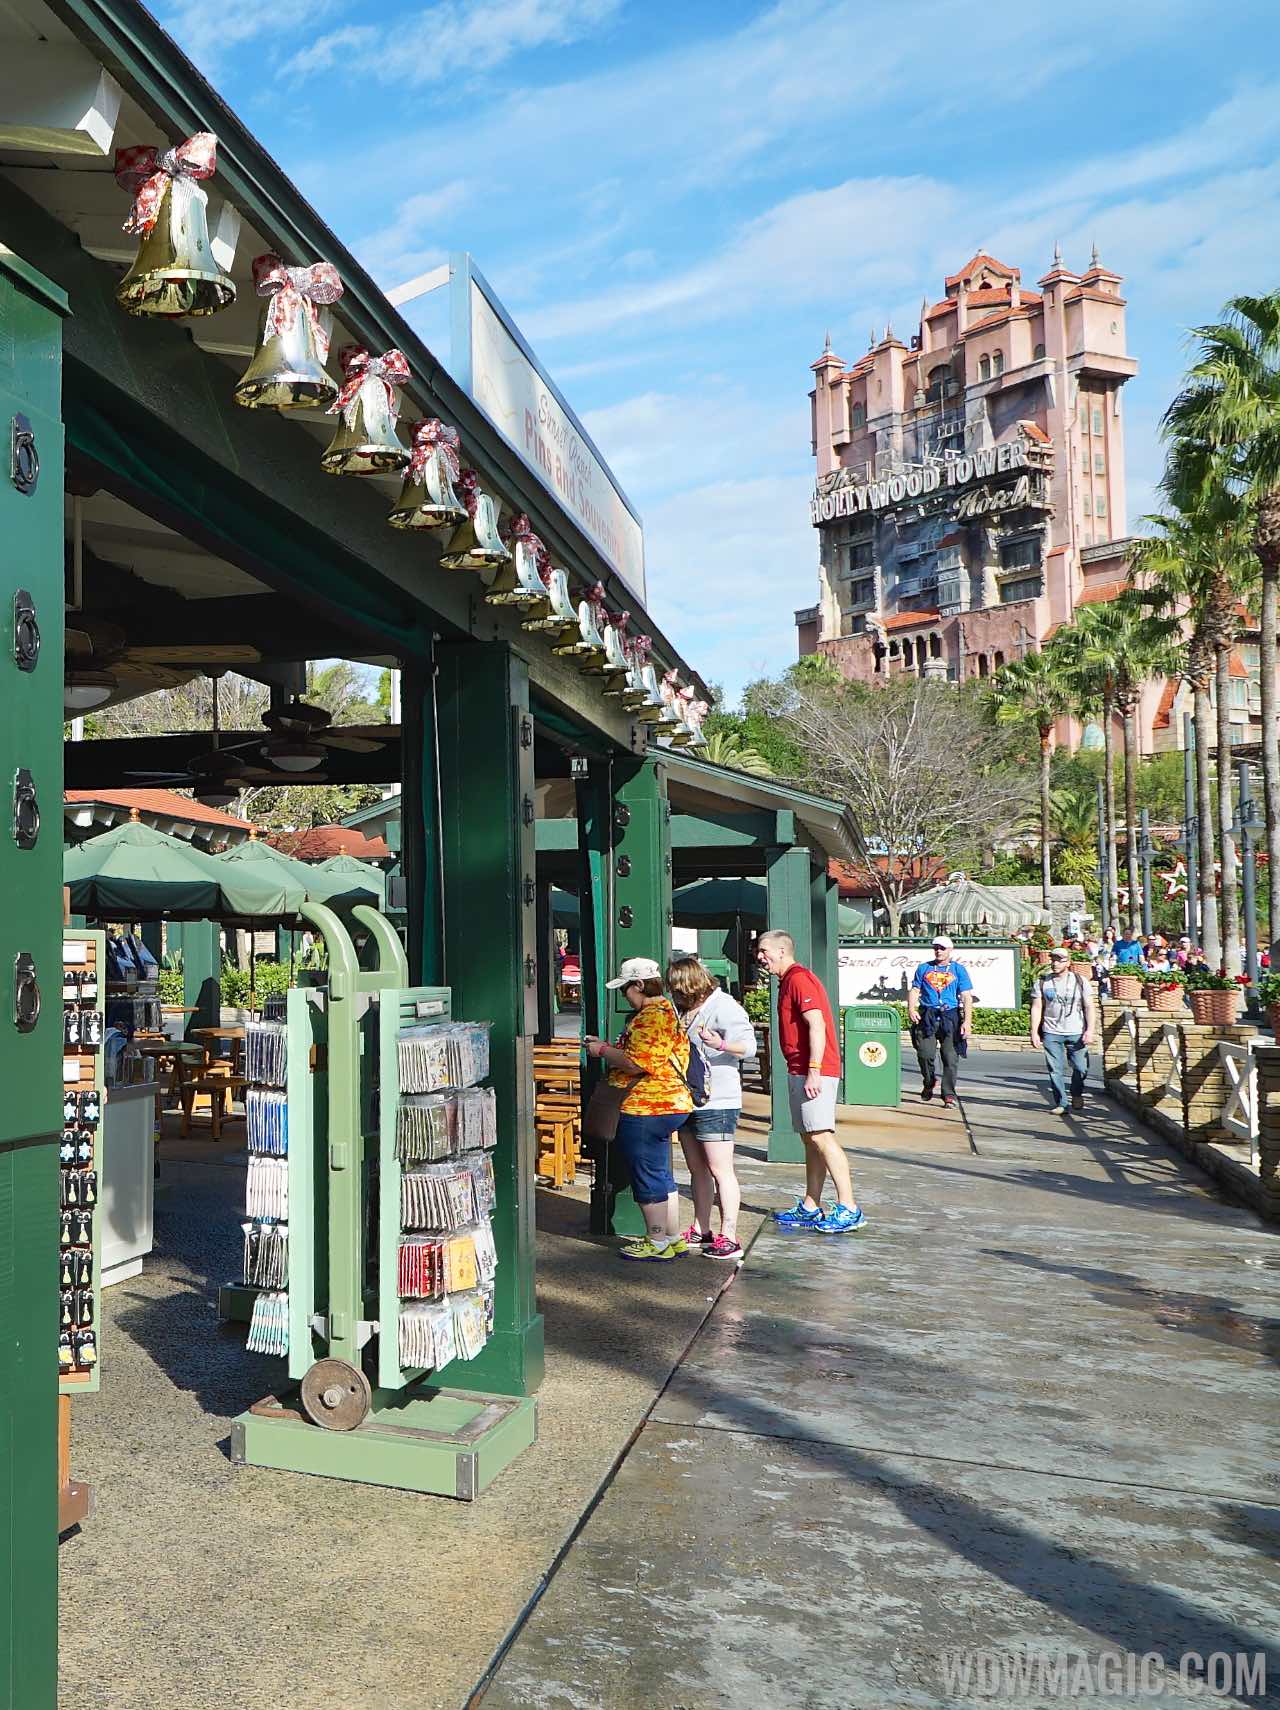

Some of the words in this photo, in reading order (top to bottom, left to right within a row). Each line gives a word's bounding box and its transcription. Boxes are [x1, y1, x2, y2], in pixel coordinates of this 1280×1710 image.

[524, 408, 552, 474] Pins
[554, 454, 576, 505] and
[809, 464, 941, 523] HOLLYWOOD
[945, 440, 1026, 486] TOWER
[821, 467, 859, 493] The
[951, 475, 1032, 521] Hotel
[837, 956, 888, 968] Sunset
